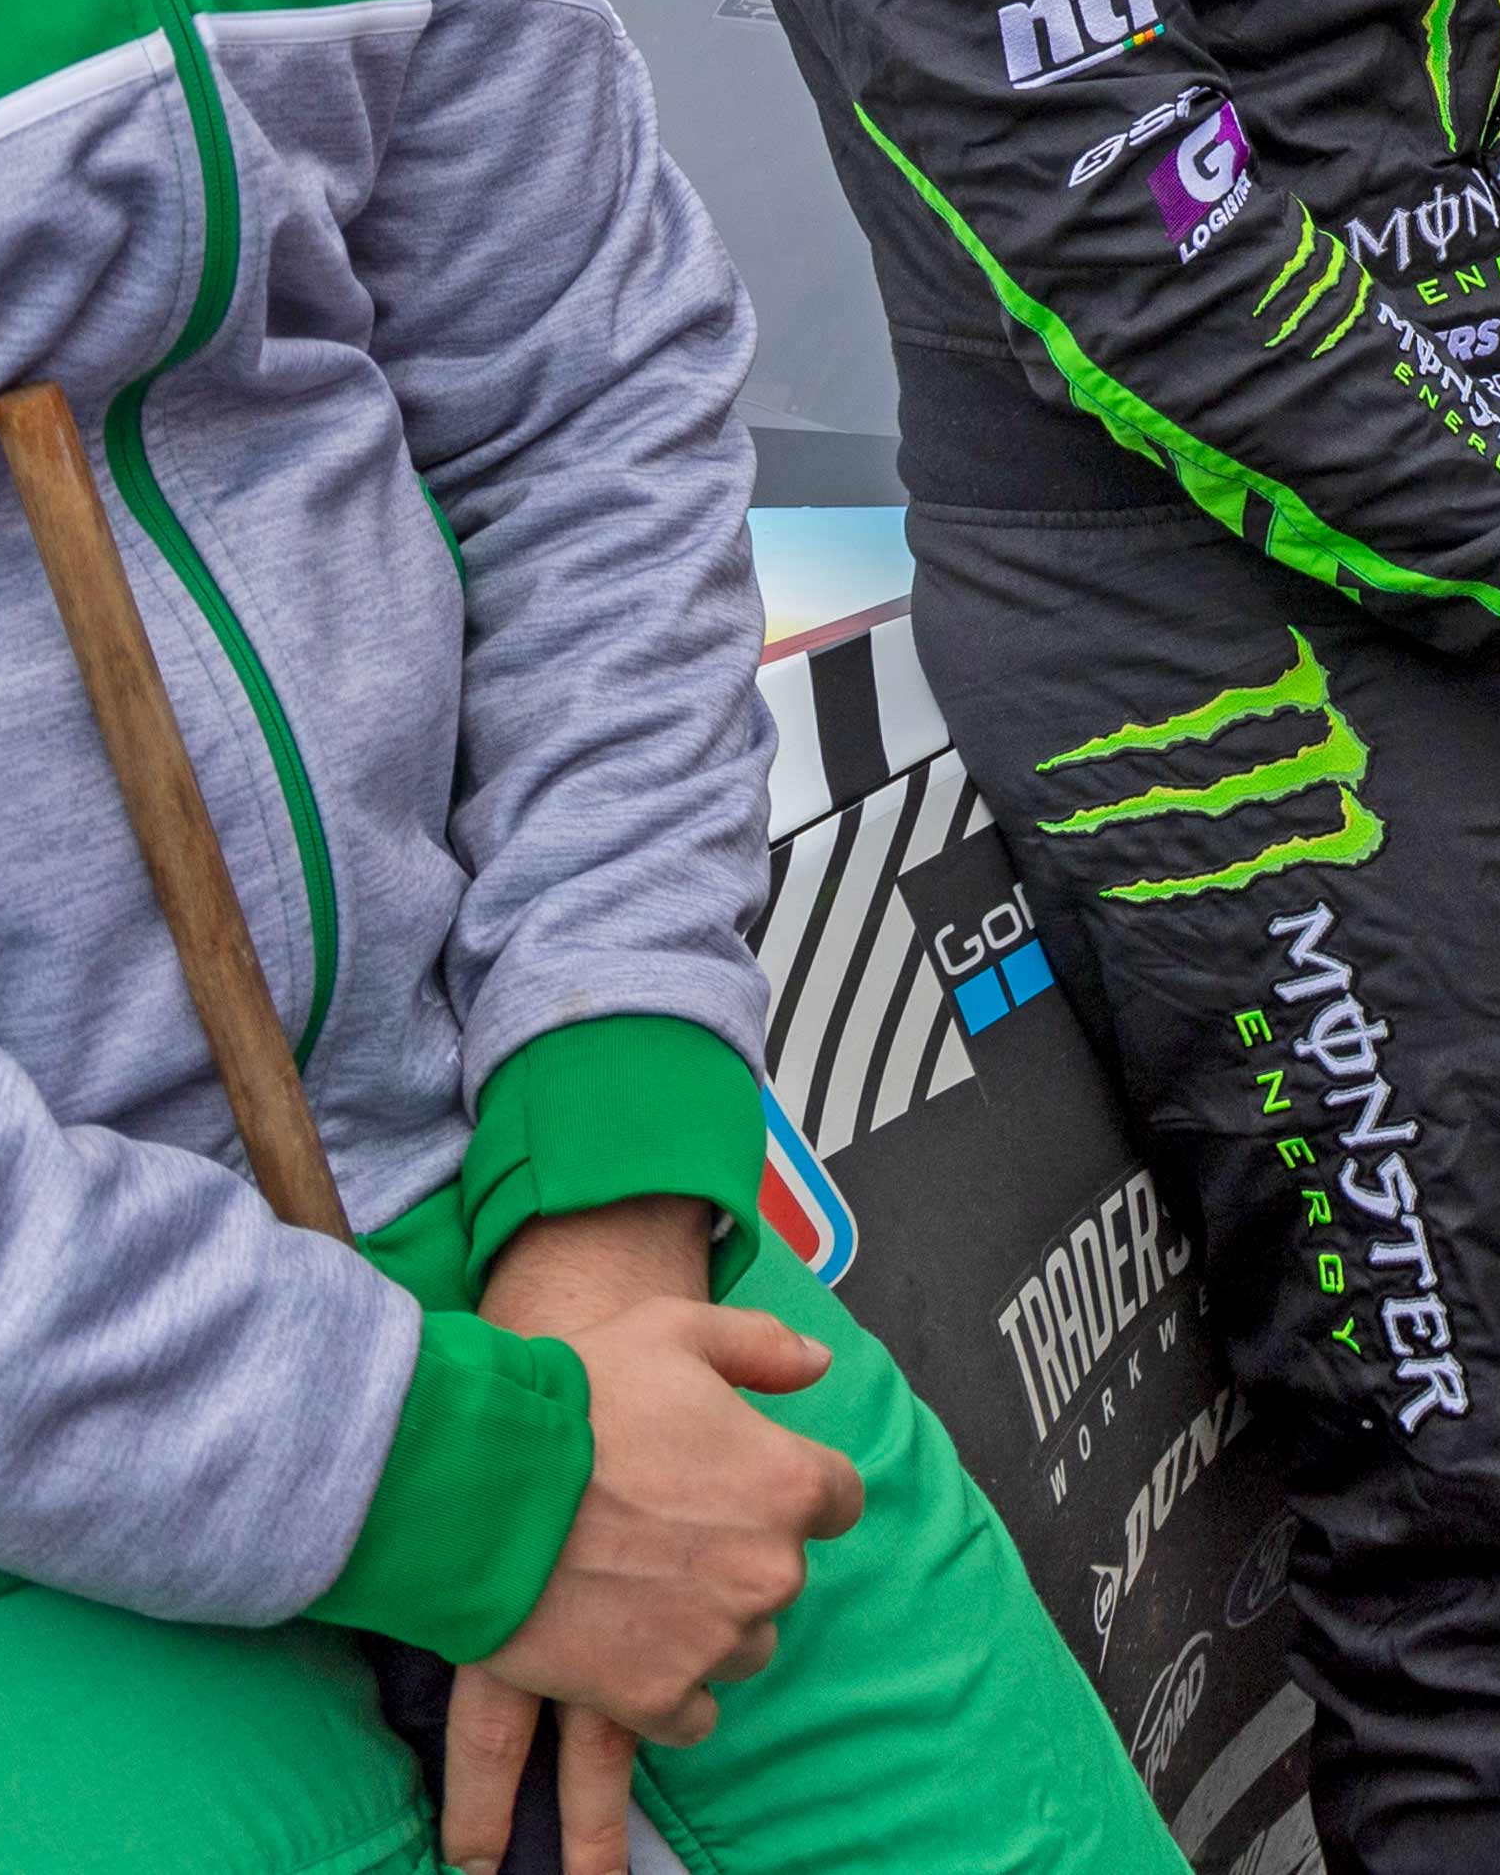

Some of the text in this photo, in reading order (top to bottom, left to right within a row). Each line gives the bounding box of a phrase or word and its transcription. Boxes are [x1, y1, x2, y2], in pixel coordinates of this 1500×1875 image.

[1234, 1009, 1363, 1356] ENERGY
[1268, 899, 1472, 1436] MONSTER
[1049, 1285, 1210, 1505] WORKWE
